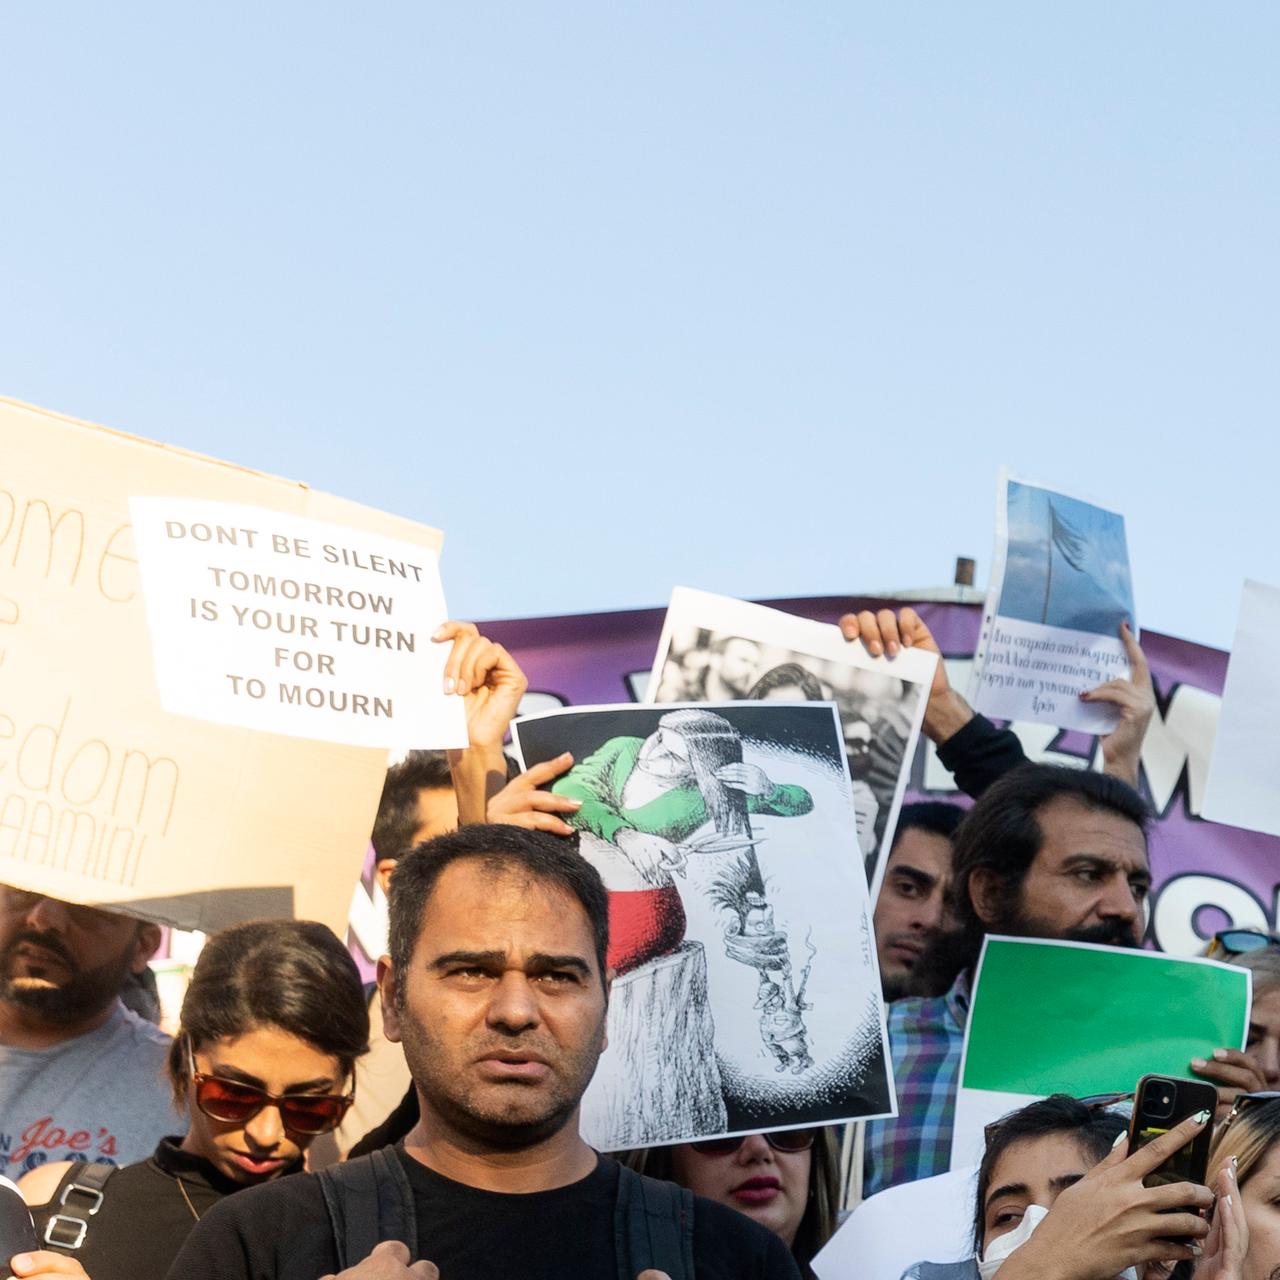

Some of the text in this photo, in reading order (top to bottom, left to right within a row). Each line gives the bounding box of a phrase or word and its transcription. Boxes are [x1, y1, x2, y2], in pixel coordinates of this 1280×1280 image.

[165, 519, 424, 583] DONT BE SILENT
[208, 566, 394, 615] TOMORROW
[190, 597, 416, 653] IS YOUR TURN
[274, 647, 335, 676] FOR
[226, 674, 394, 718] TO MOURN
[9, 1115, 117, 1163] Joe's
